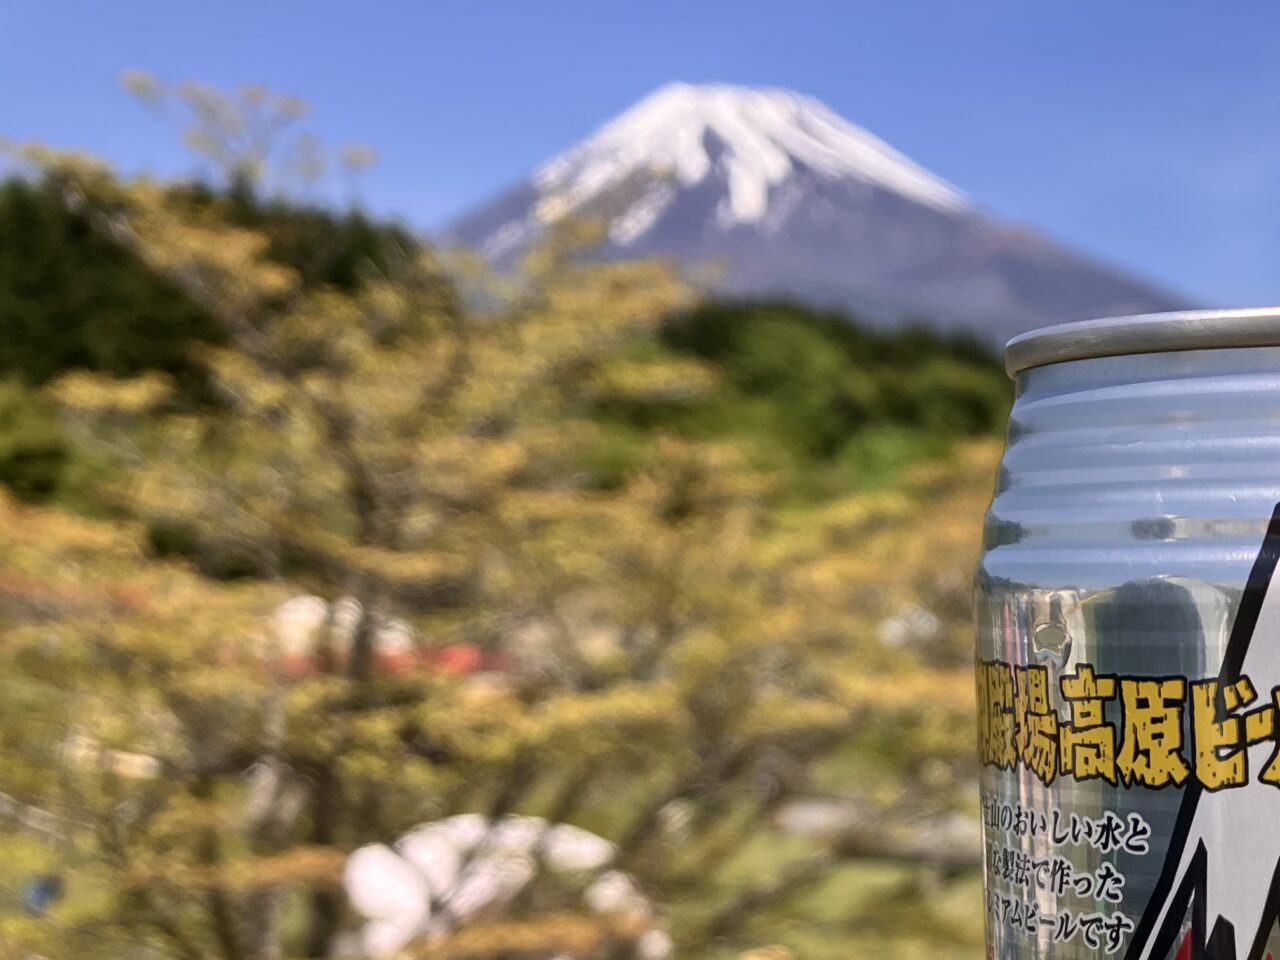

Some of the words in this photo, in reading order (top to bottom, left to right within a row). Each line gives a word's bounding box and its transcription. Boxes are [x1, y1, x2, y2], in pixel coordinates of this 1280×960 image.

[986, 841, 1126, 902] な製法で作った
